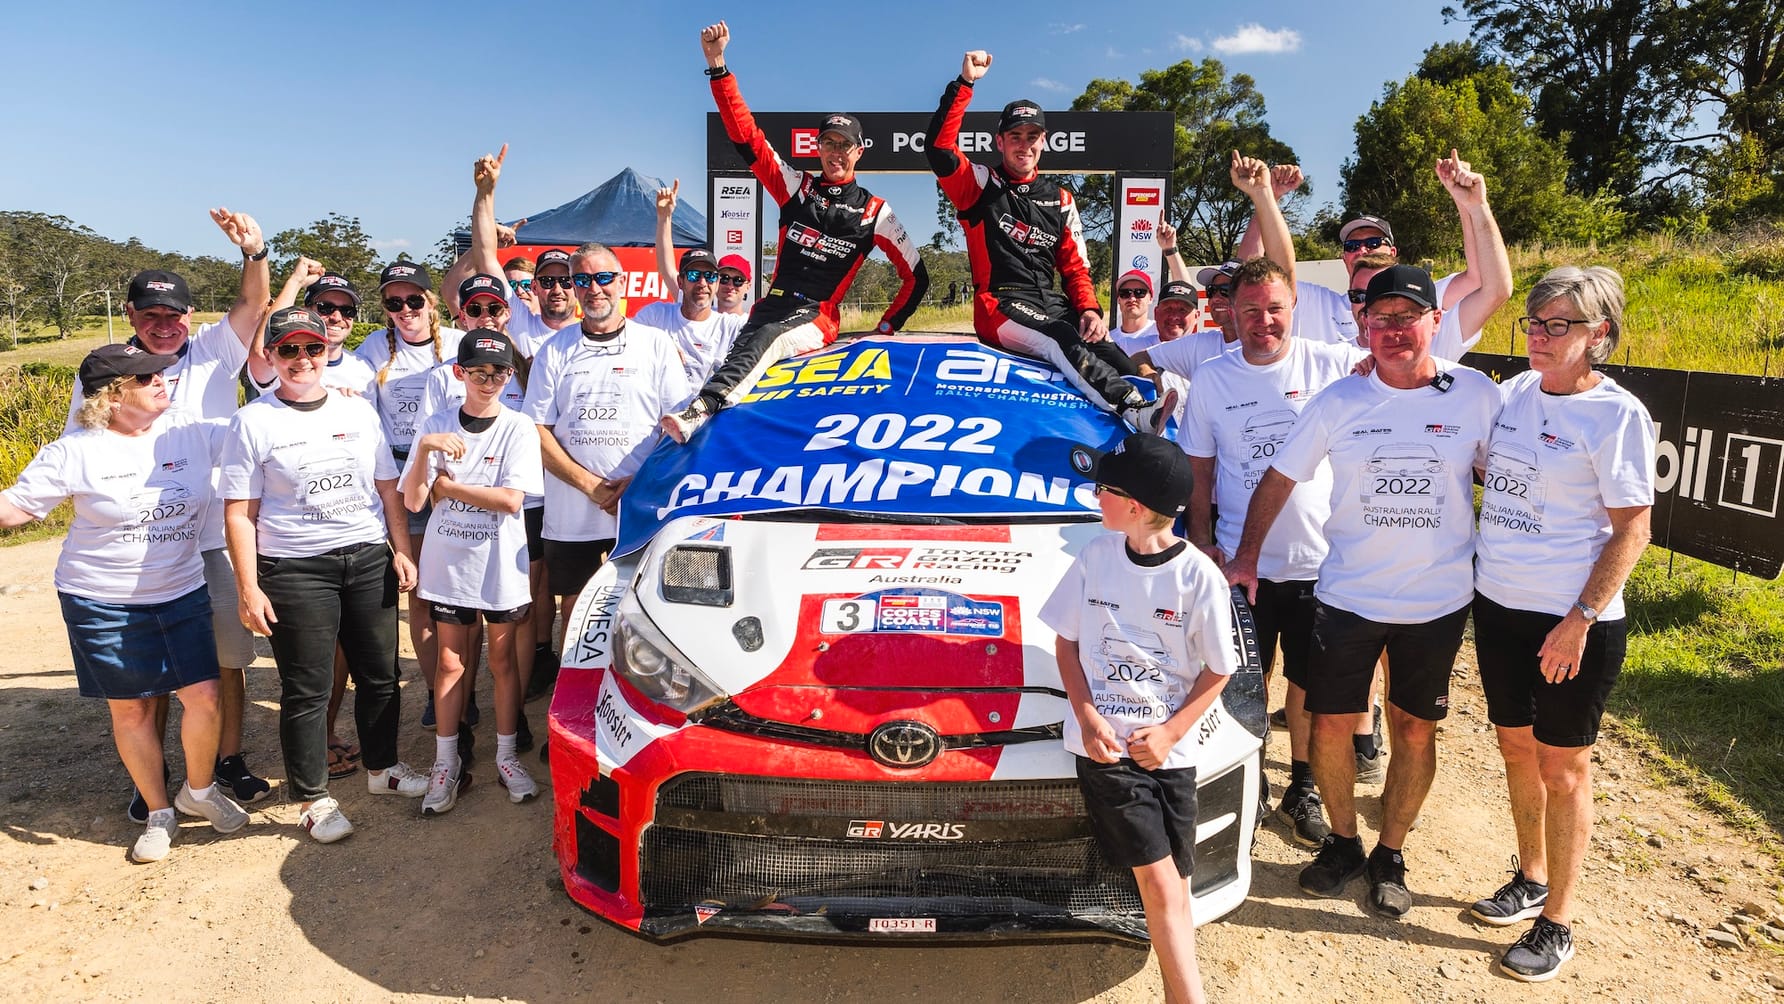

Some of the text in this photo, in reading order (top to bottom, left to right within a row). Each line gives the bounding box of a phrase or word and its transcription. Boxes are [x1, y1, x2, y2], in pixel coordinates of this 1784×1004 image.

[893, 132, 992, 152] POER
[722, 187, 751, 195] RSEA
[720, 210, 750, 219] Hoosier
[786, 225, 819, 248] GR
[999, 219, 1029, 243] GR
[1131, 232, 1152, 240] NSW
[818, 239, 851, 254] GAZOO
[822, 234, 857, 250] TOYOTA
[814, 242, 847, 259] Racing
[756, 348, 892, 388] SEA
[796, 384, 892, 398] SAFETY
[935, 389, 1088, 409] RALLY CHAMPIONSH
[936, 382, 1088, 403] MOTORSPORT AUSTR
[398, 401, 418, 412] 20
[578, 408, 617, 421] 2022
[570, 436, 630, 447] CHAMPIONS
[803, 413, 1003, 454] 2022
[1252, 441, 1284, 459] 20
[1654, 421, 1762, 505] bil 1
[308, 474, 353, 495] 2022
[1375, 478, 1431, 495] 2022
[1486, 472, 1528, 499] 2022
[302, 495, 365, 511] AUSTRALIAN RALLY
[302, 501, 367, 521] CHAMPIONS
[1363, 505, 1442, 516] AUSTRALIAN RALLY
[140, 503, 186, 523] 2022
[1364, 513, 1441, 529] CHAMPIONS
[1516, 509, 1542, 522] RALLY
[1481, 511, 1543, 534] AMPIONS
[123, 530, 196, 544] CHAMPIONS
[437, 525, 498, 541] CHAMPIONS
[803, 551, 909, 569] GR
[917, 554, 1022, 565] GAZOO
[918, 547, 1034, 558] TOYOTA
[912, 561, 1017, 574] Racing
[868, 573, 963, 585] Australia
[836, 601, 861, 632] 3
[882, 608, 942, 618] COFFS
[971, 607, 1001, 617] NSW
[1153, 608, 1175, 622] GR
[580, 586, 626, 663] DAMESA
[881, 616, 940, 626] COAST
[1107, 664, 1163, 683] 2022
[596, 689, 633, 748] Hoosier
[1096, 704, 1176, 720] CHAMPION
[847, 821, 884, 838] GR
